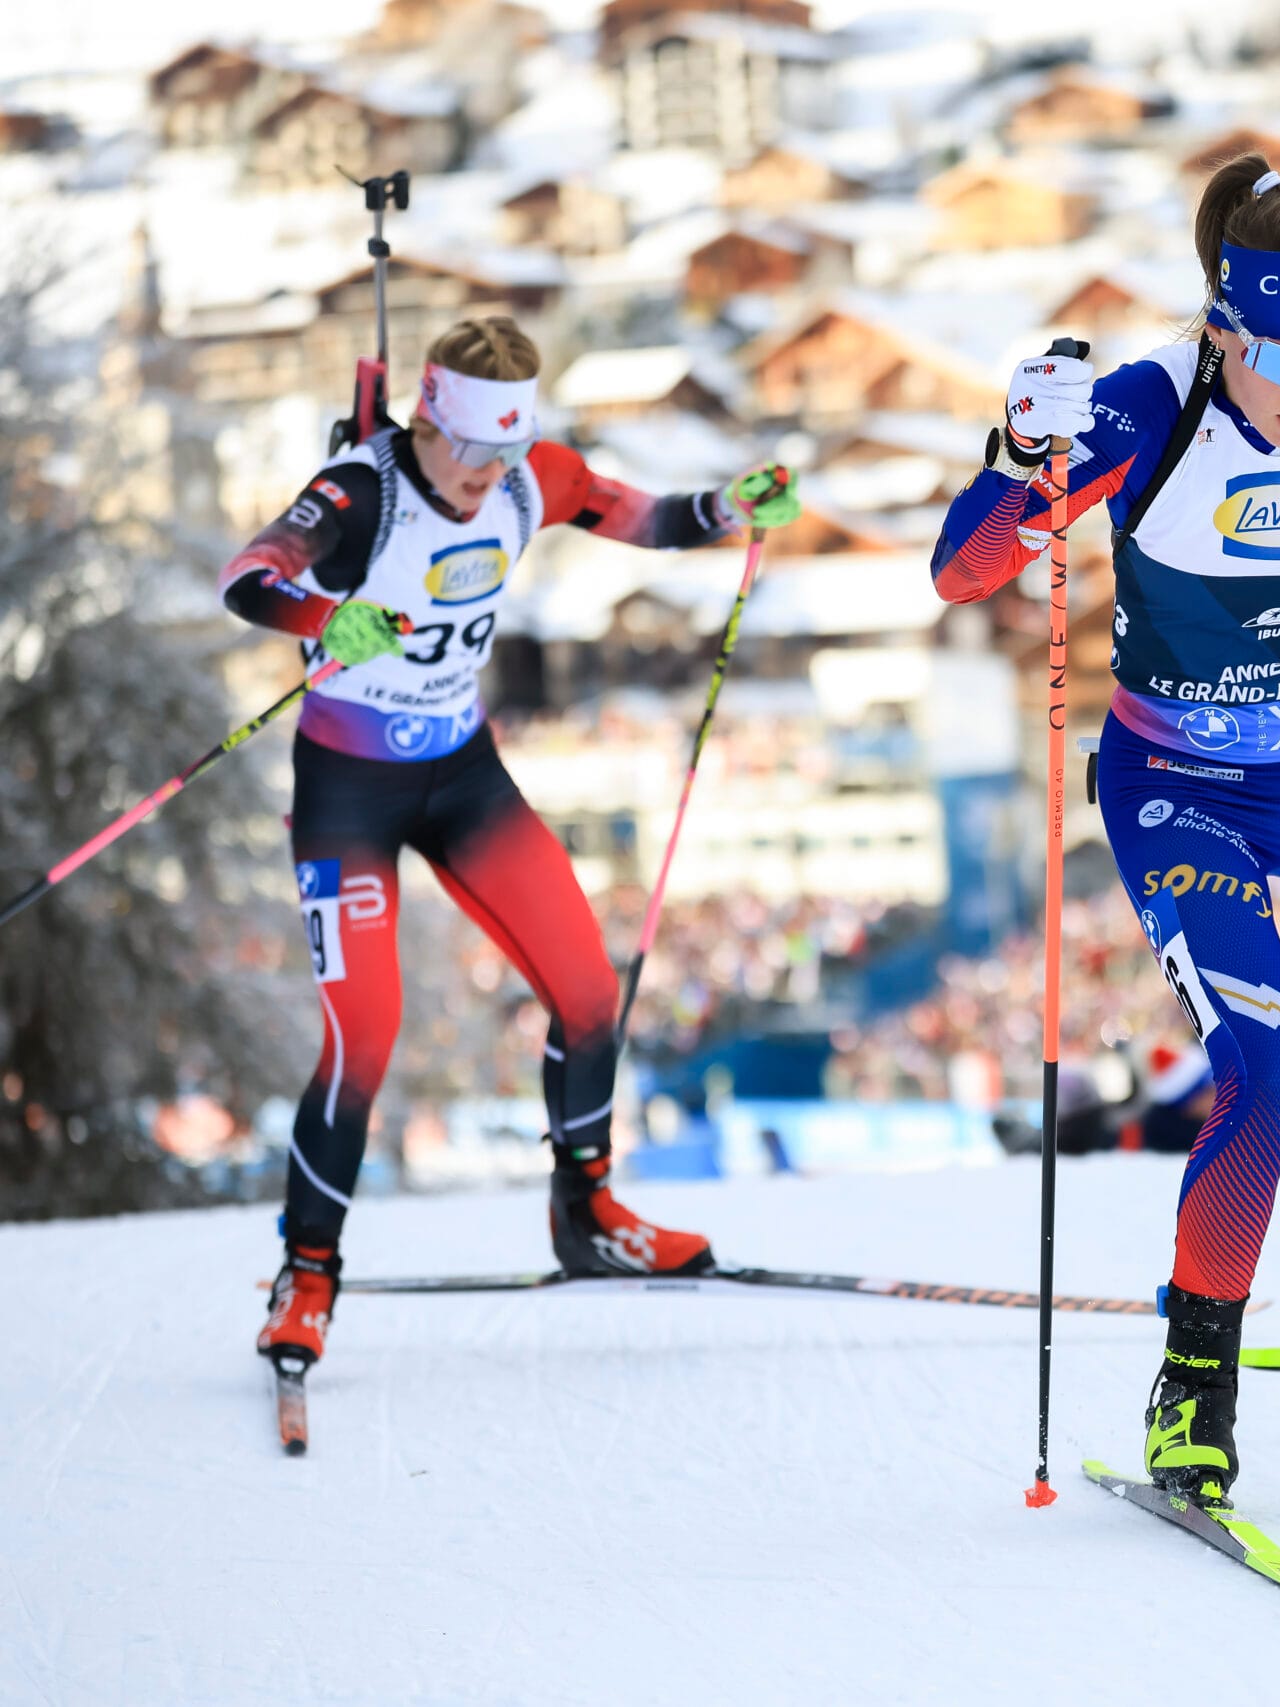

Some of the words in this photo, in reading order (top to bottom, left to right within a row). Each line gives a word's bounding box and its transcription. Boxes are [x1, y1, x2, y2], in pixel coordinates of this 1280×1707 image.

[404, 611, 495, 666] 39
[1149, 676, 1174, 696] LE
[1143, 864, 1272, 919] somfy
